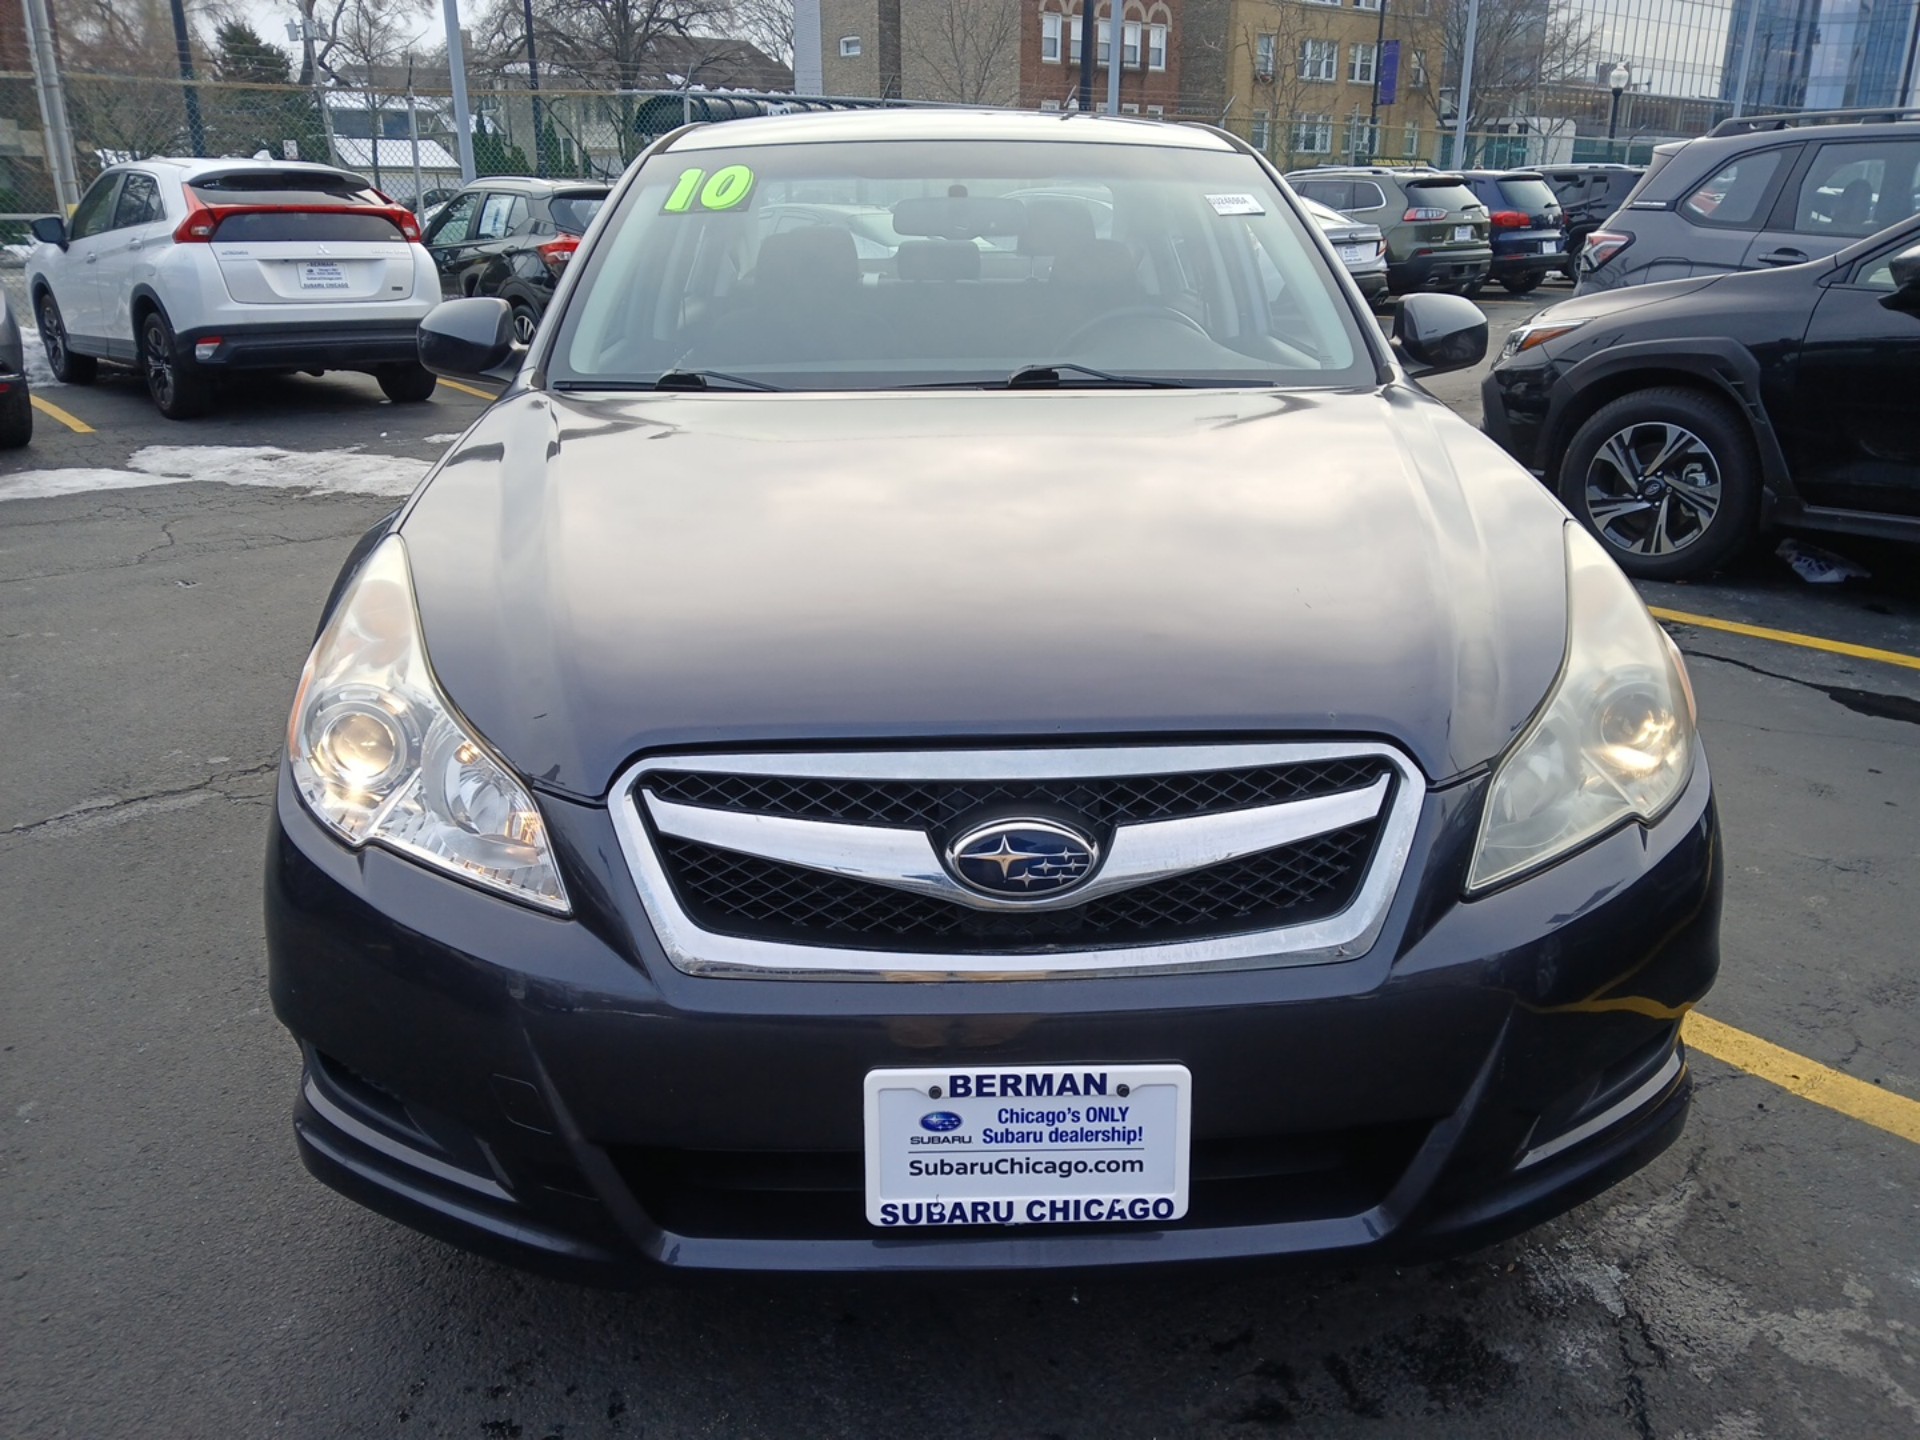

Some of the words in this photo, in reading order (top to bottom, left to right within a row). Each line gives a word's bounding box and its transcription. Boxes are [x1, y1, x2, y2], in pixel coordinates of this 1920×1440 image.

[664, 164, 754, 211] 10
[949, 1073, 1108, 1098] BERMAN
[997, 1107, 1081, 1127] Chicago's
[1085, 1106, 1130, 1123] ONLY
[910, 1135, 972, 1145] SUBARU
[982, 1128, 1045, 1144] Subaru
[1048, 1126, 1144, 1146] dealership!
[908, 1157, 1145, 1178] SubaruChicago.com
[880, 1201, 1014, 1225] SUBARU
[1026, 1198, 1175, 1222] CHICAGO
